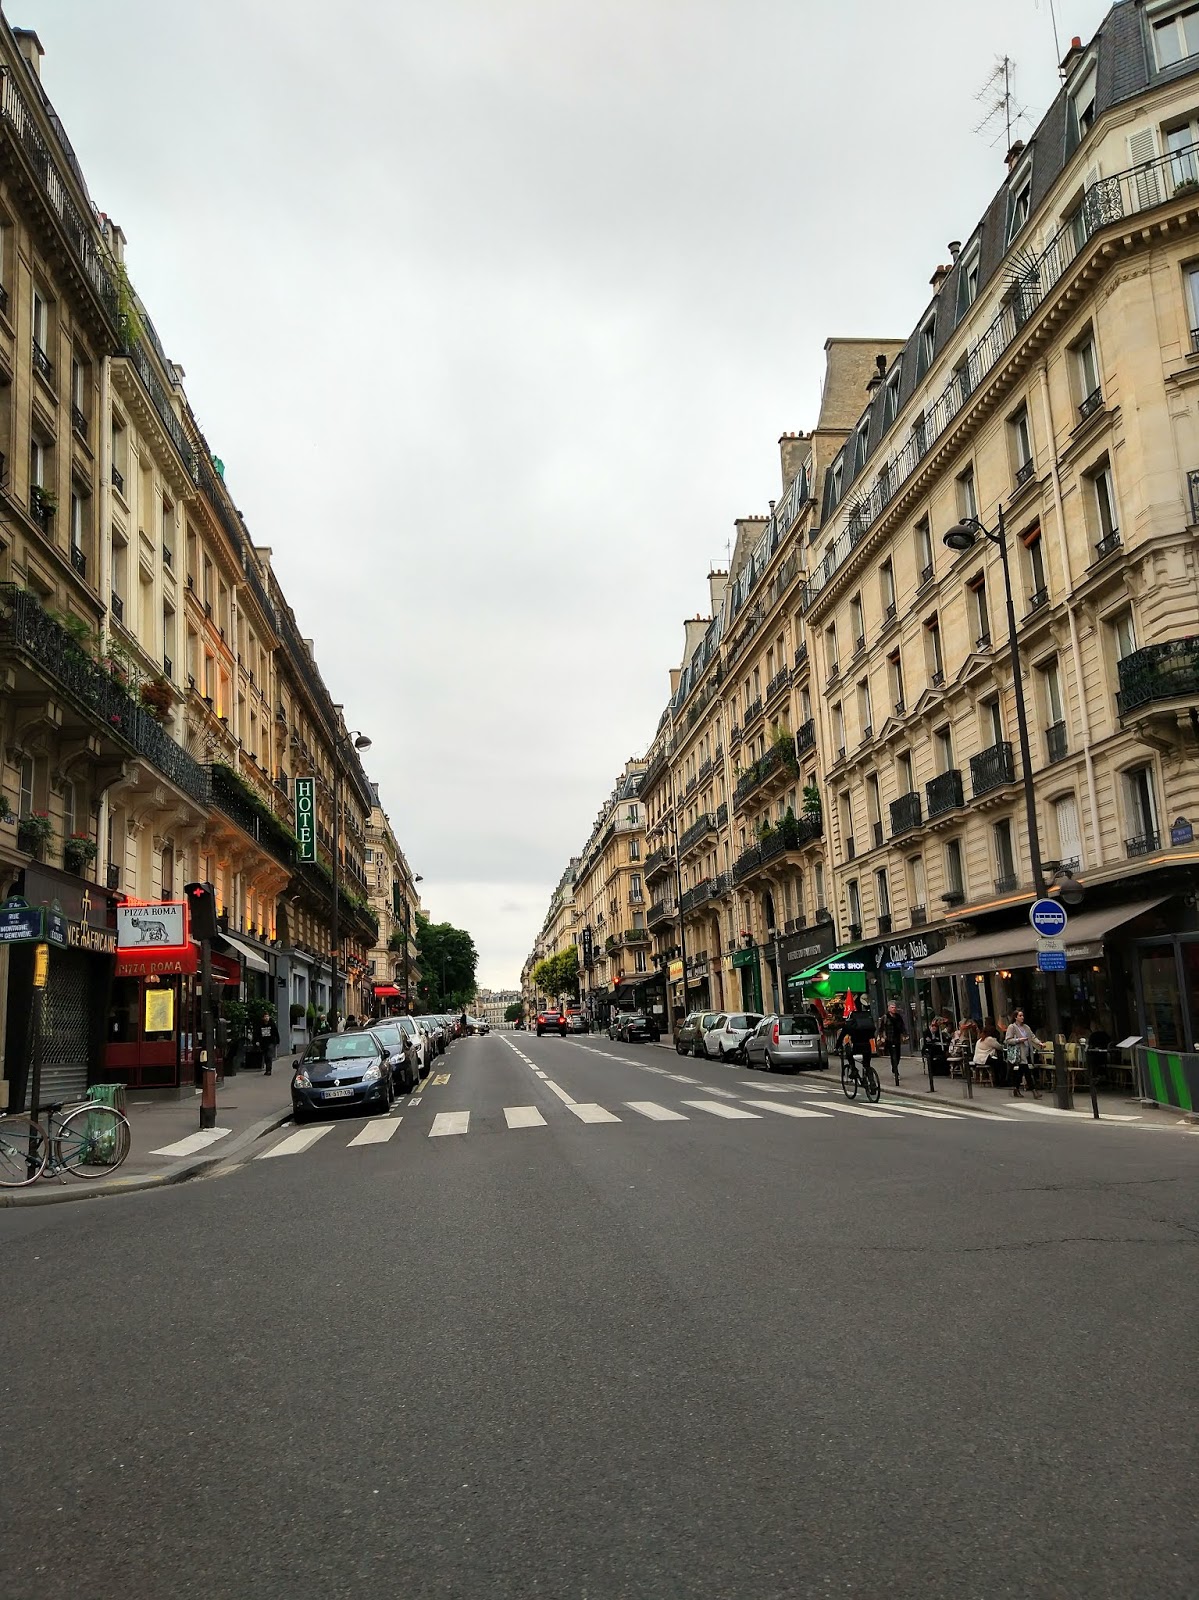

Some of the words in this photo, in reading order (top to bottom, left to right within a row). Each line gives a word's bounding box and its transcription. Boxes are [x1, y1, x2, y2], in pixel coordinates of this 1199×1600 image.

[298, 781, 312, 858] HOTEL
[376, 853, 384, 888] HOTEL
[8, 912, 20, 920] RUE
[124, 908, 149, 917] PIZZA
[151, 907, 177, 916] ROMA
[86, 931, 118, 954] AFRICAINE
[889, 943, 908, 962] Chloé
[908, 939, 928, 960] Nails
[118, 963, 146, 974] PIZZA
[150, 961, 182, 973] ROMA
